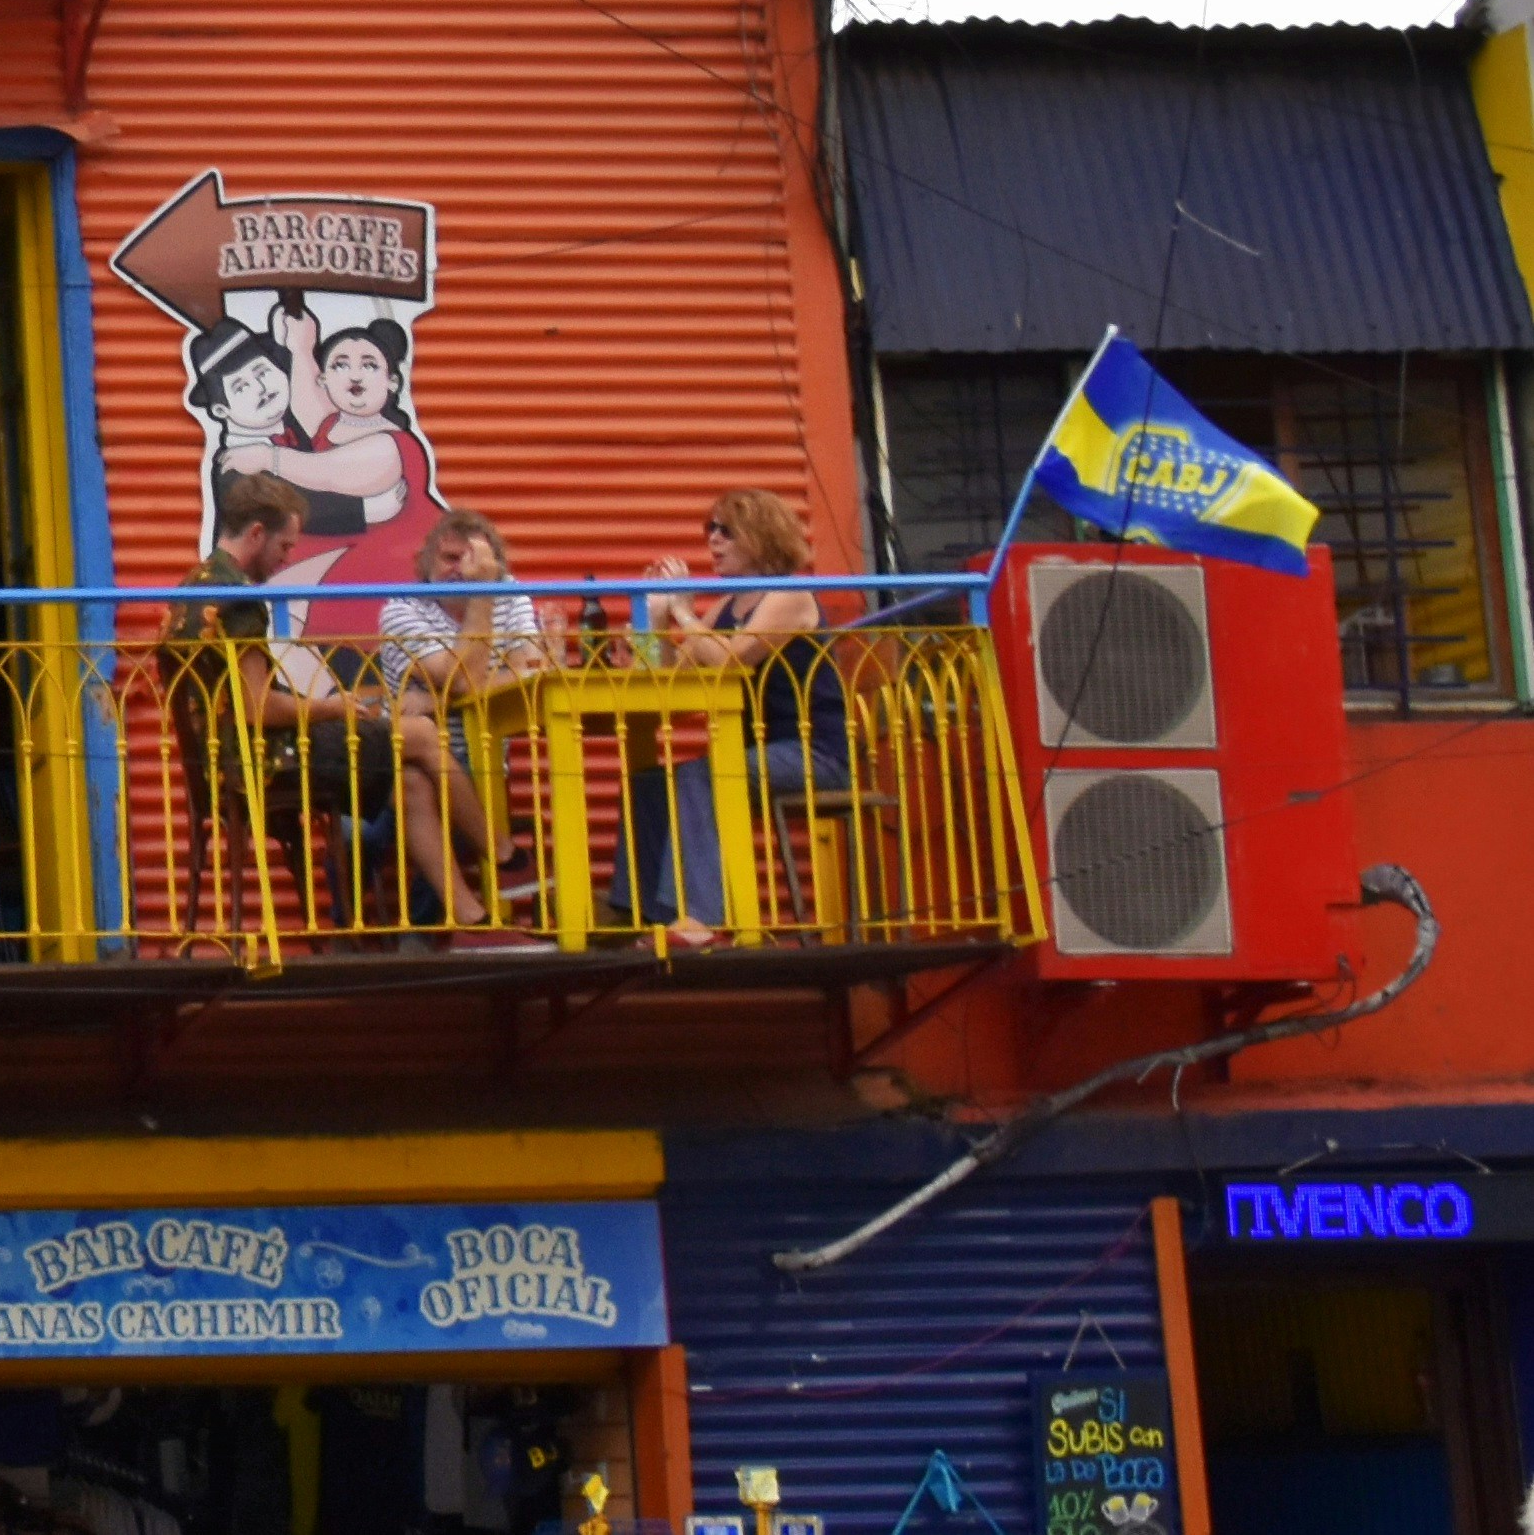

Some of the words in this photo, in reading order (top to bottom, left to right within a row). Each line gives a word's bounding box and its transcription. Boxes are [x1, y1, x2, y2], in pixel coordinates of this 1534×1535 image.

[236, 214, 307, 243] BAR
[315, 214, 400, 249] CAFE
[221, 243, 418, 280] ALFAJORES
[1124, 454, 1229, 497] CABJ
[29, 1224, 141, 1289] BAR
[149, 1220, 286, 1285] CAFÉ
[449, 1226, 577, 1270] BOCA
[422, 1271, 612, 1321] OFICIAL
[110, 1300, 340, 1340] CACHEMIR
